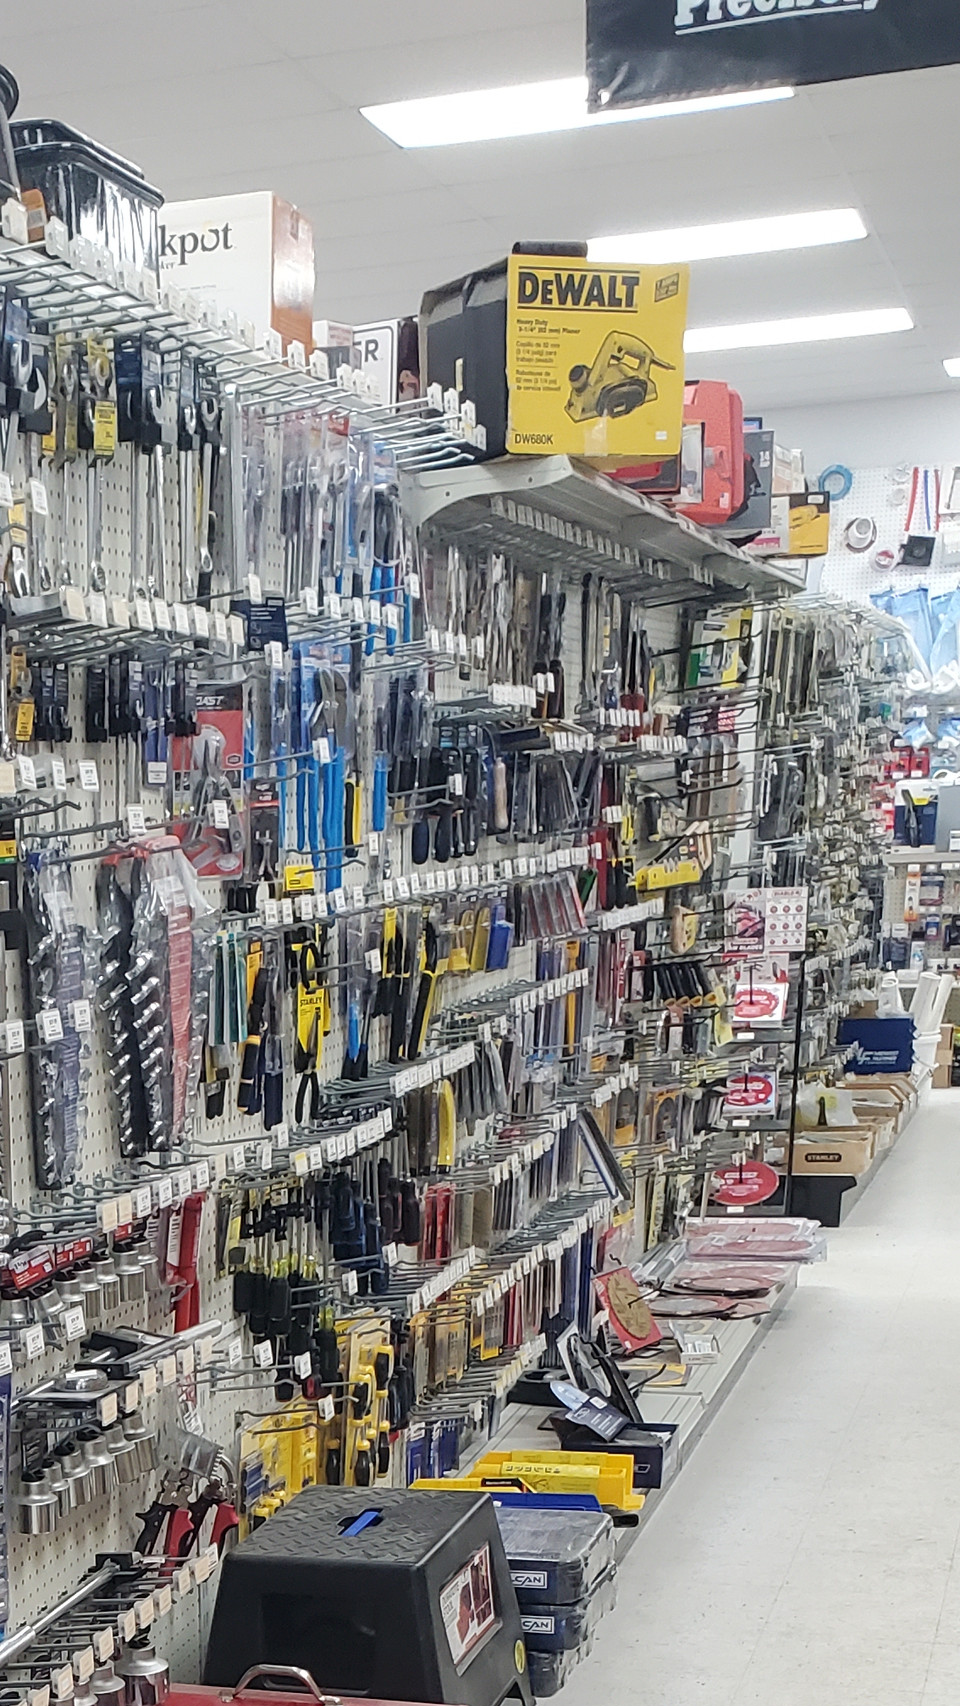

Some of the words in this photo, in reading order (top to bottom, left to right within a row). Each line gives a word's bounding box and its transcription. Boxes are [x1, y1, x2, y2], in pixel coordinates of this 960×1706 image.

[515, 434, 554, 445] DW680K
[511, 1575, 542, 1585] CAN
[523, 1620, 549, 1629] CAN
